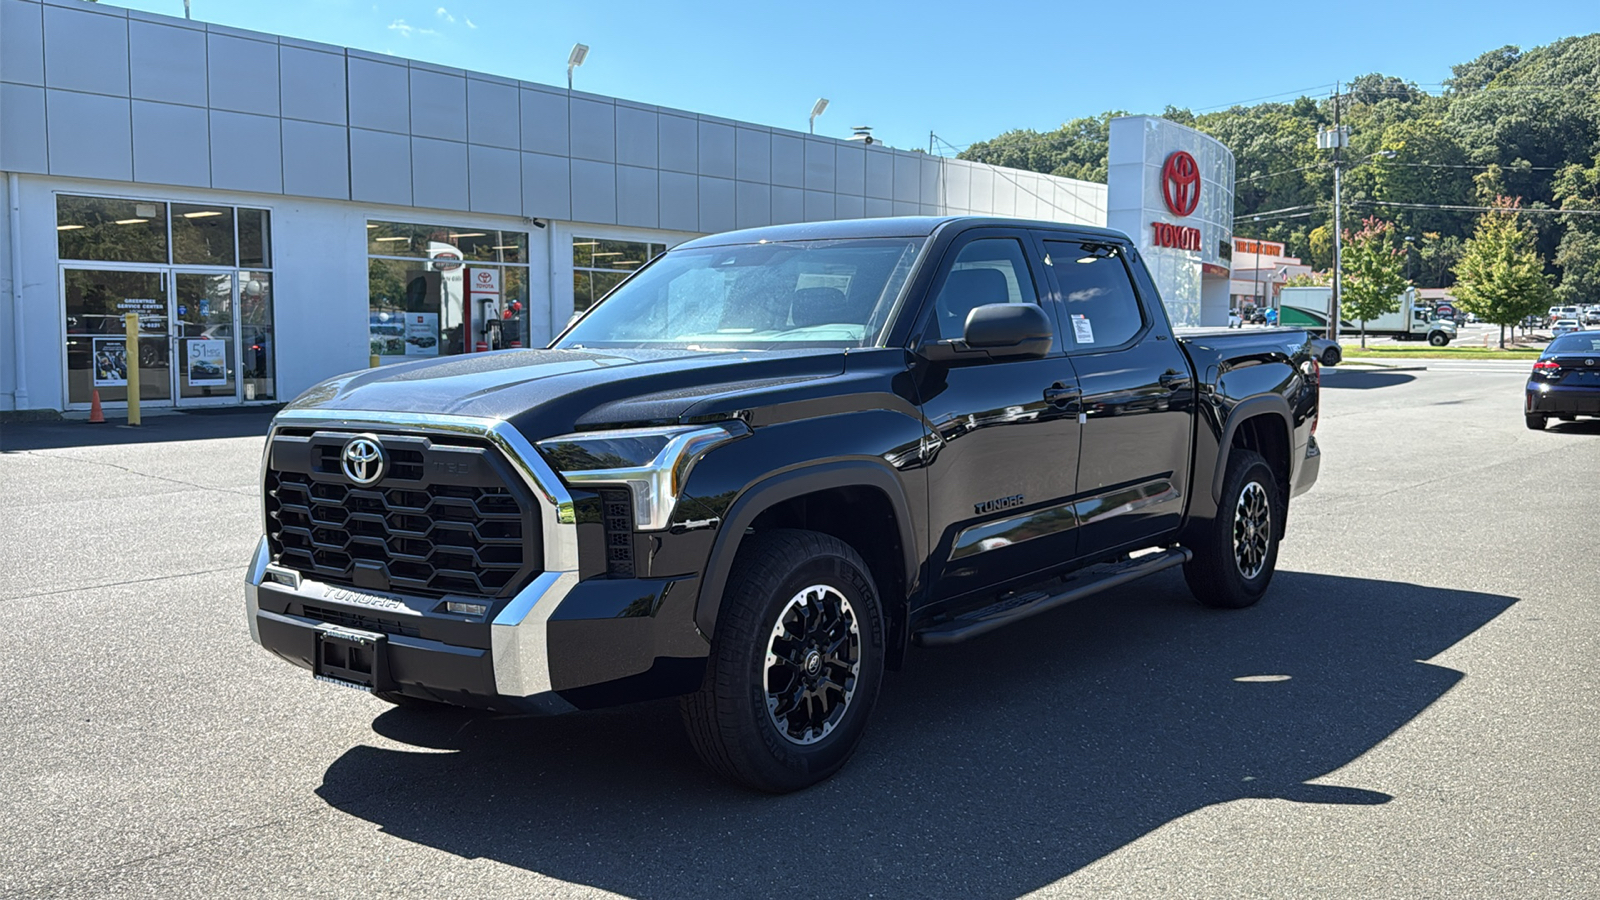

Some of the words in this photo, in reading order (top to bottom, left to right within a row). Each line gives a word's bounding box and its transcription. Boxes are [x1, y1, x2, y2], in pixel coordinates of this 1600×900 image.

[1151, 222, 1202, 251] TOYOTA
[1234, 240, 1247, 253] THE
[192, 343, 206, 358] 51
[432, 461, 469, 475] TRD
[974, 494, 1024, 514] TUNDRA
[323, 587, 402, 609] TUNDRA
[315, 675, 373, 692] GREENTREE
